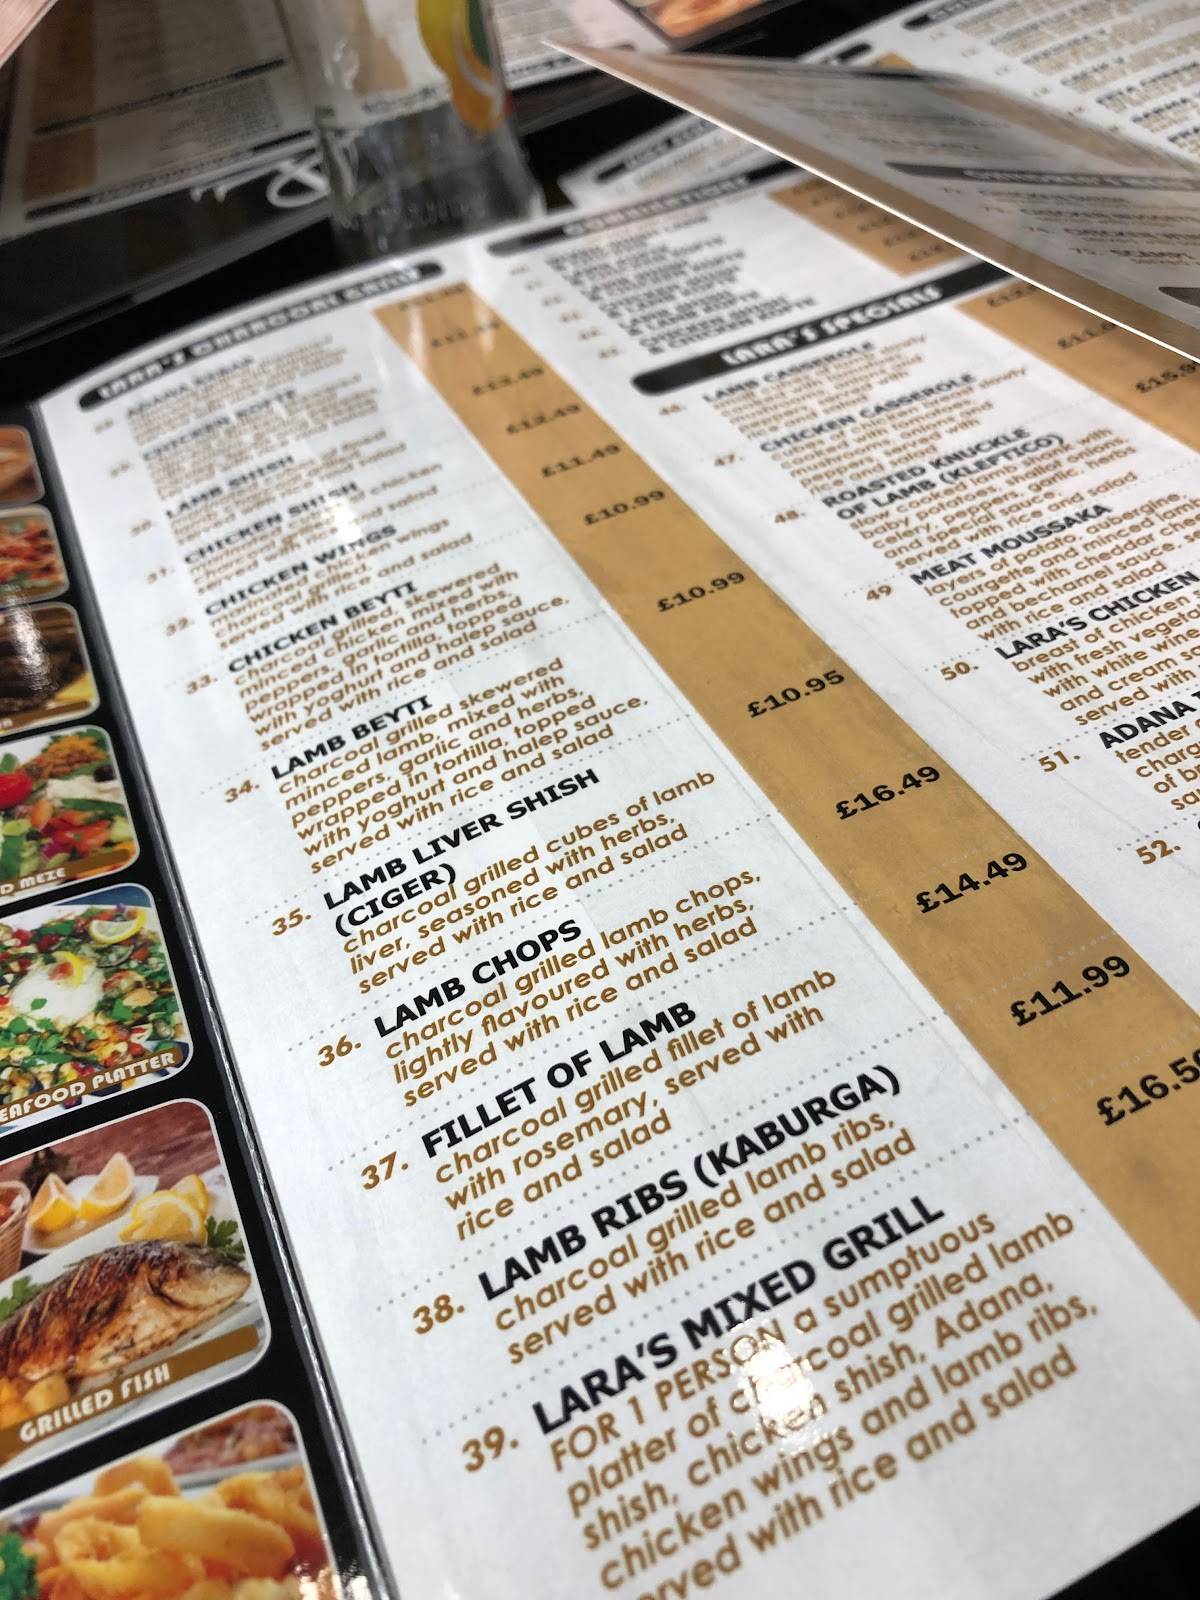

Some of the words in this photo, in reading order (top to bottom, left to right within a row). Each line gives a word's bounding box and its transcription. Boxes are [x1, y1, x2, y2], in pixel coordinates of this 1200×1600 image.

[760, 415, 857, 452] CHICKEN
[859, 374, 974, 418] CASSEROLE
[821, 466, 926, 508] ROASTED
[929, 428, 1030, 470] KNUCKLE
[836, 502, 867, 520] OF
[871, 480, 937, 507] LAMB
[939, 434, 1068, 485] (KLEFTICO)
[185, 513, 283, 565] CHICKEN
[584, 490, 665, 526] £10.99
[910, 552, 977, 585] MEAT
[980, 504, 1112, 559] MOUSSAKA
[205, 561, 309, 615] CHICKEN
[657, 572, 745, 612] £10.99
[866, 585, 892, 600] 49
[949, 582, 1027, 619] topped
[1029, 567, 1071, 587] with
[1074, 533, 1155, 570] cheddar
[228, 614, 338, 673] CHICKEN
[344, 581, 417, 619] BEYTI
[994, 616, 1088, 660] LARA'S
[1088, 571, 1198, 621] CHICKEN
[1011, 638, 1080, 672] breast
[1084, 627, 1105, 643] of
[1109, 596, 1191, 633] chicken
[187, 674, 217, 694] 33.
[748, 669, 845, 718] £10.95
[940, 661, 979, 681] 50.
[1027, 662, 1073, 684] with
[1073, 640, 1127, 666] fresh
[1042, 674, 1089, 697] with
[1090, 651, 1148, 678] white
[271, 735, 346, 780] LAMB
[351, 695, 432, 740] BEYTI
[279, 736, 379, 794] charcoal
[385, 703, 453, 745] grilled
[459, 657, 563, 710] skewered
[285, 757, 371, 810] minced
[376, 732, 440, 765] lamb,
[447, 693, 516, 733] mixed
[520, 676, 565, 700] with
[291, 772, 396, 829] peppers,
[398, 738, 467, 777] garlic
[468, 712, 512, 740] and
[516, 688, 583, 720] herbs,
[1038, 750, 1081, 772] 51.
[1099, 701, 1197, 749] ADANA
[1115, 725, 1190, 763] tender
[225, 779, 260, 803] 34.
[836, 766, 942, 820] £16.49
[20, 867, 66, 889] MEZE
[323, 857, 407, 910] LAMB
[412, 813, 504, 865] LIVER
[506, 768, 600, 820] SHISH
[344, 882, 457, 953] charcoal
[464, 845, 540, 896] grilled
[546, 813, 620, 853] cubes
[626, 795, 649, 817] of
[652, 772, 715, 805] lamb
[1136, 840, 1181, 865] 52.
[335, 863, 456, 937] (CIGER)
[350, 937, 410, 975] liver,
[418, 867, 540, 939] seasoned
[545, 845, 596, 875] with
[600, 814, 675, 851] herbs,
[916, 849, 1027, 914] £14.49
[272, 908, 311, 936] 35.
[374, 977, 466, 1038] LAMB
[472, 919, 581, 984] CHOPS
[386, 981, 508, 1059] charcoal
[515, 938, 604, 996] grilled
[600, 908, 669, 949] lamb
[675, 871, 760, 913] chops,
[393, 1029, 473, 1084] lightly
[481, 957, 610, 1037] flavoured
[614, 933, 669, 967] with
[673, 894, 753, 941] herbs,
[1010, 956, 1130, 1027] £11.99
[92, 1052, 174, 1089] PLATTER
[318, 1035, 362, 1067] 36.
[421, 1077, 536, 1158] FILLET
[547, 1049, 592, 1089] OF
[599, 1002, 696, 1063] LAMB
[436, 1096, 567, 1183] charcoal
[575, 1048, 663, 1114] grilled
[667, 1018, 725, 1062] fillet
[732, 1000, 759, 1029] of
[762, 970, 836, 1014] lamb
[445, 1166, 506, 1210] with
[512, 1091, 664, 1176] rosemary,
[664, 1031, 762, 1095] served
[764, 1006, 824, 1043] with
[361, 1151, 409, 1190] 37.
[478, 1224, 586, 1301] LAMB
[591, 1169, 688, 1238] RIBS
[694, 1065, 900, 1188] (KABURGA)
[496, 1233, 639, 1331] charcoal
[646, 1179, 742, 1260] grilled
[745, 1142, 826, 1195] lamb
[832, 1113, 894, 1151] ribs,
[413, 1294, 465, 1335] 38.
[532, 1332, 678, 1435] LARA'S
[681, 1260, 816, 1350] MIXED
[823, 1196, 945, 1270] GRILL
[550, 1412, 621, 1472] FOR
[627, 1396, 645, 1425] 1
[655, 1318, 786, 1412] PERSON
[794, 1307, 819, 1333] a
[823, 1213, 995, 1318] sumptuous
[20, 1388, 113, 1442] GRILLED
[121, 1363, 170, 1399] FISH
[567, 1427, 677, 1519] platter
[687, 1395, 721, 1438] of
[887, 1252, 988, 1334] grilled
[987, 1212, 1074, 1270] lamb
[462, 1426, 519, 1472] 39.
[577, 1481, 678, 1551] shish,
[834, 1328, 926, 1404] shish,
[935, 1273, 1054, 1349] Adana,
[600, 1488, 747, 1591] chicken
[752, 1426, 855, 1509] wings
[861, 1375, 931, 1436] and
[931, 1330, 1024, 1395] lamb
[1027, 1295, 1098, 1343] ribs,
[747, 1493, 824, 1553] with
[828, 1453, 898, 1509] rice
[906, 1398, 977, 1463] and
[980, 1343, 1078, 1419] salad
